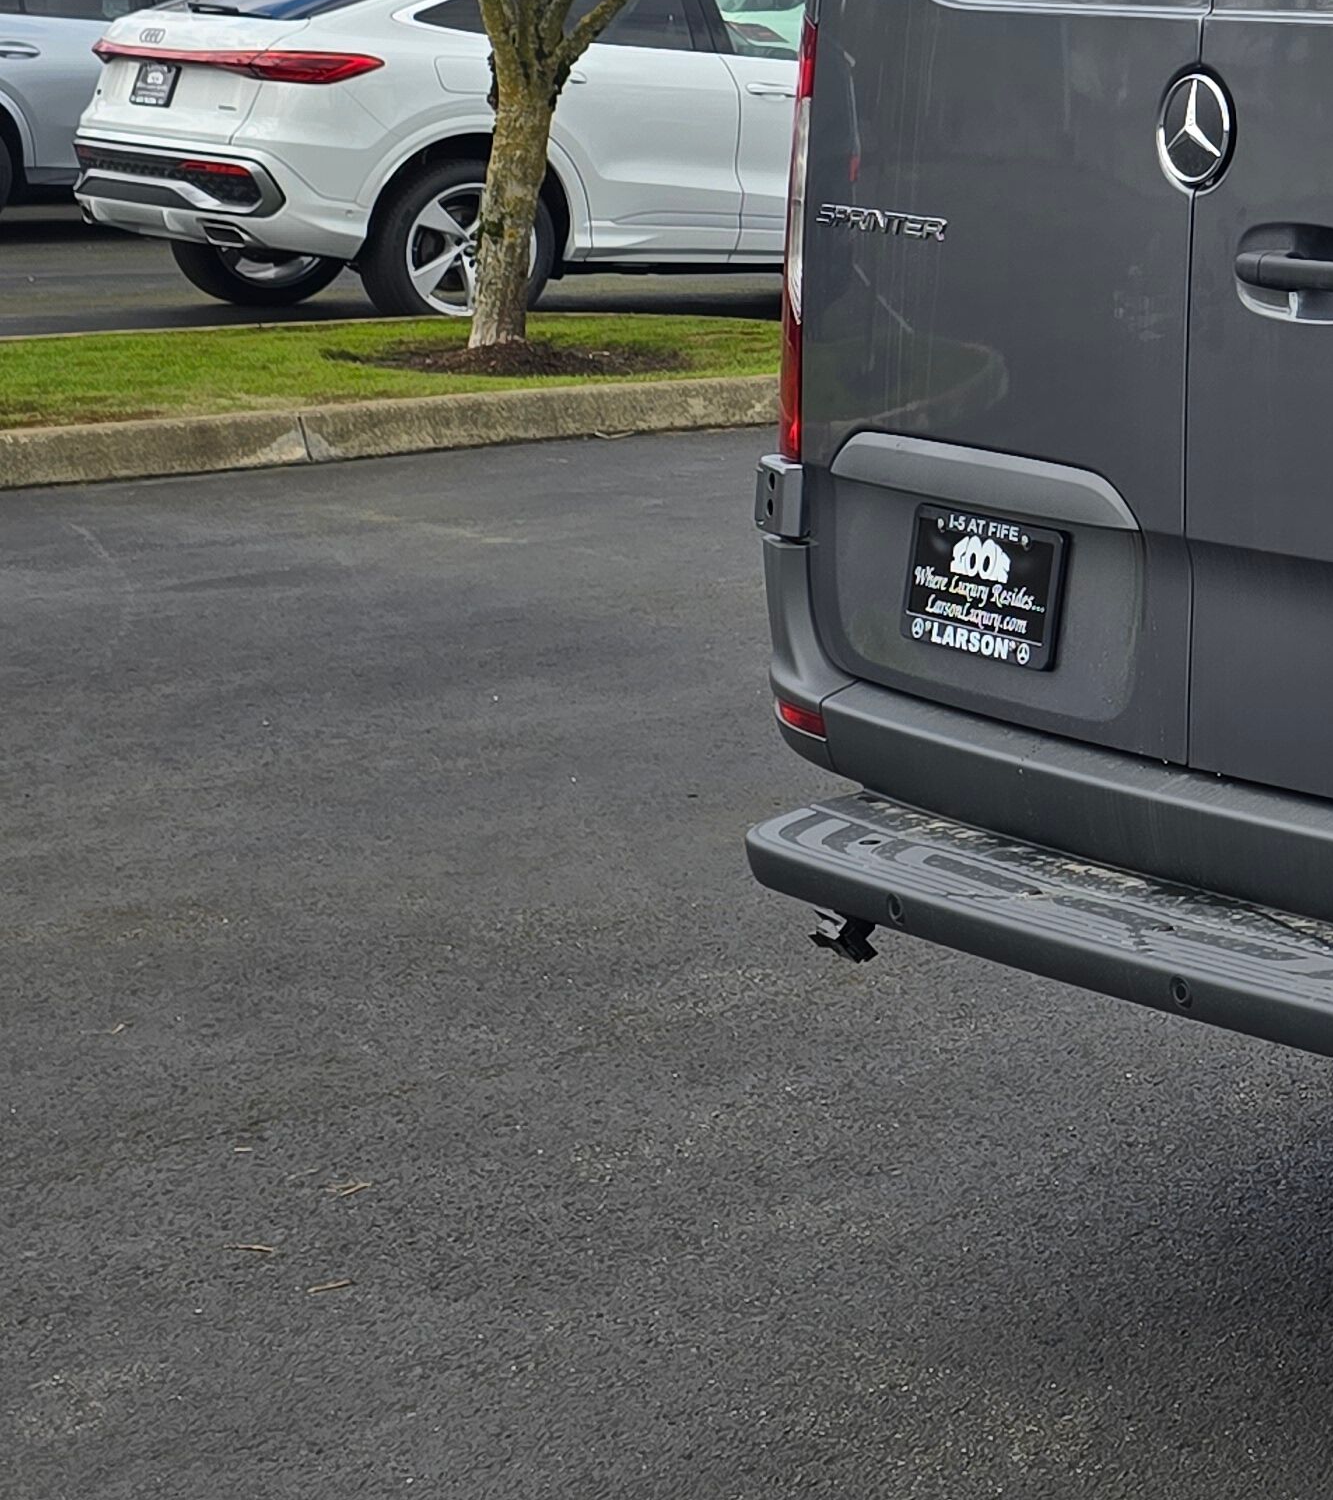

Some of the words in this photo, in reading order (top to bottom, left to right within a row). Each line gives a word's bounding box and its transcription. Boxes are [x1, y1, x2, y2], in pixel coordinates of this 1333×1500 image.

[815, 202, 949, 242] SPRINTER
[949, 514, 966, 532] I-5
[966, 519, 987, 535] AT
[987, 522, 1020, 543] FIFE
[914, 565, 949, 591] Where
[949, 575, 990, 607] Luxury
[930, 622, 1010, 660] LARSON
